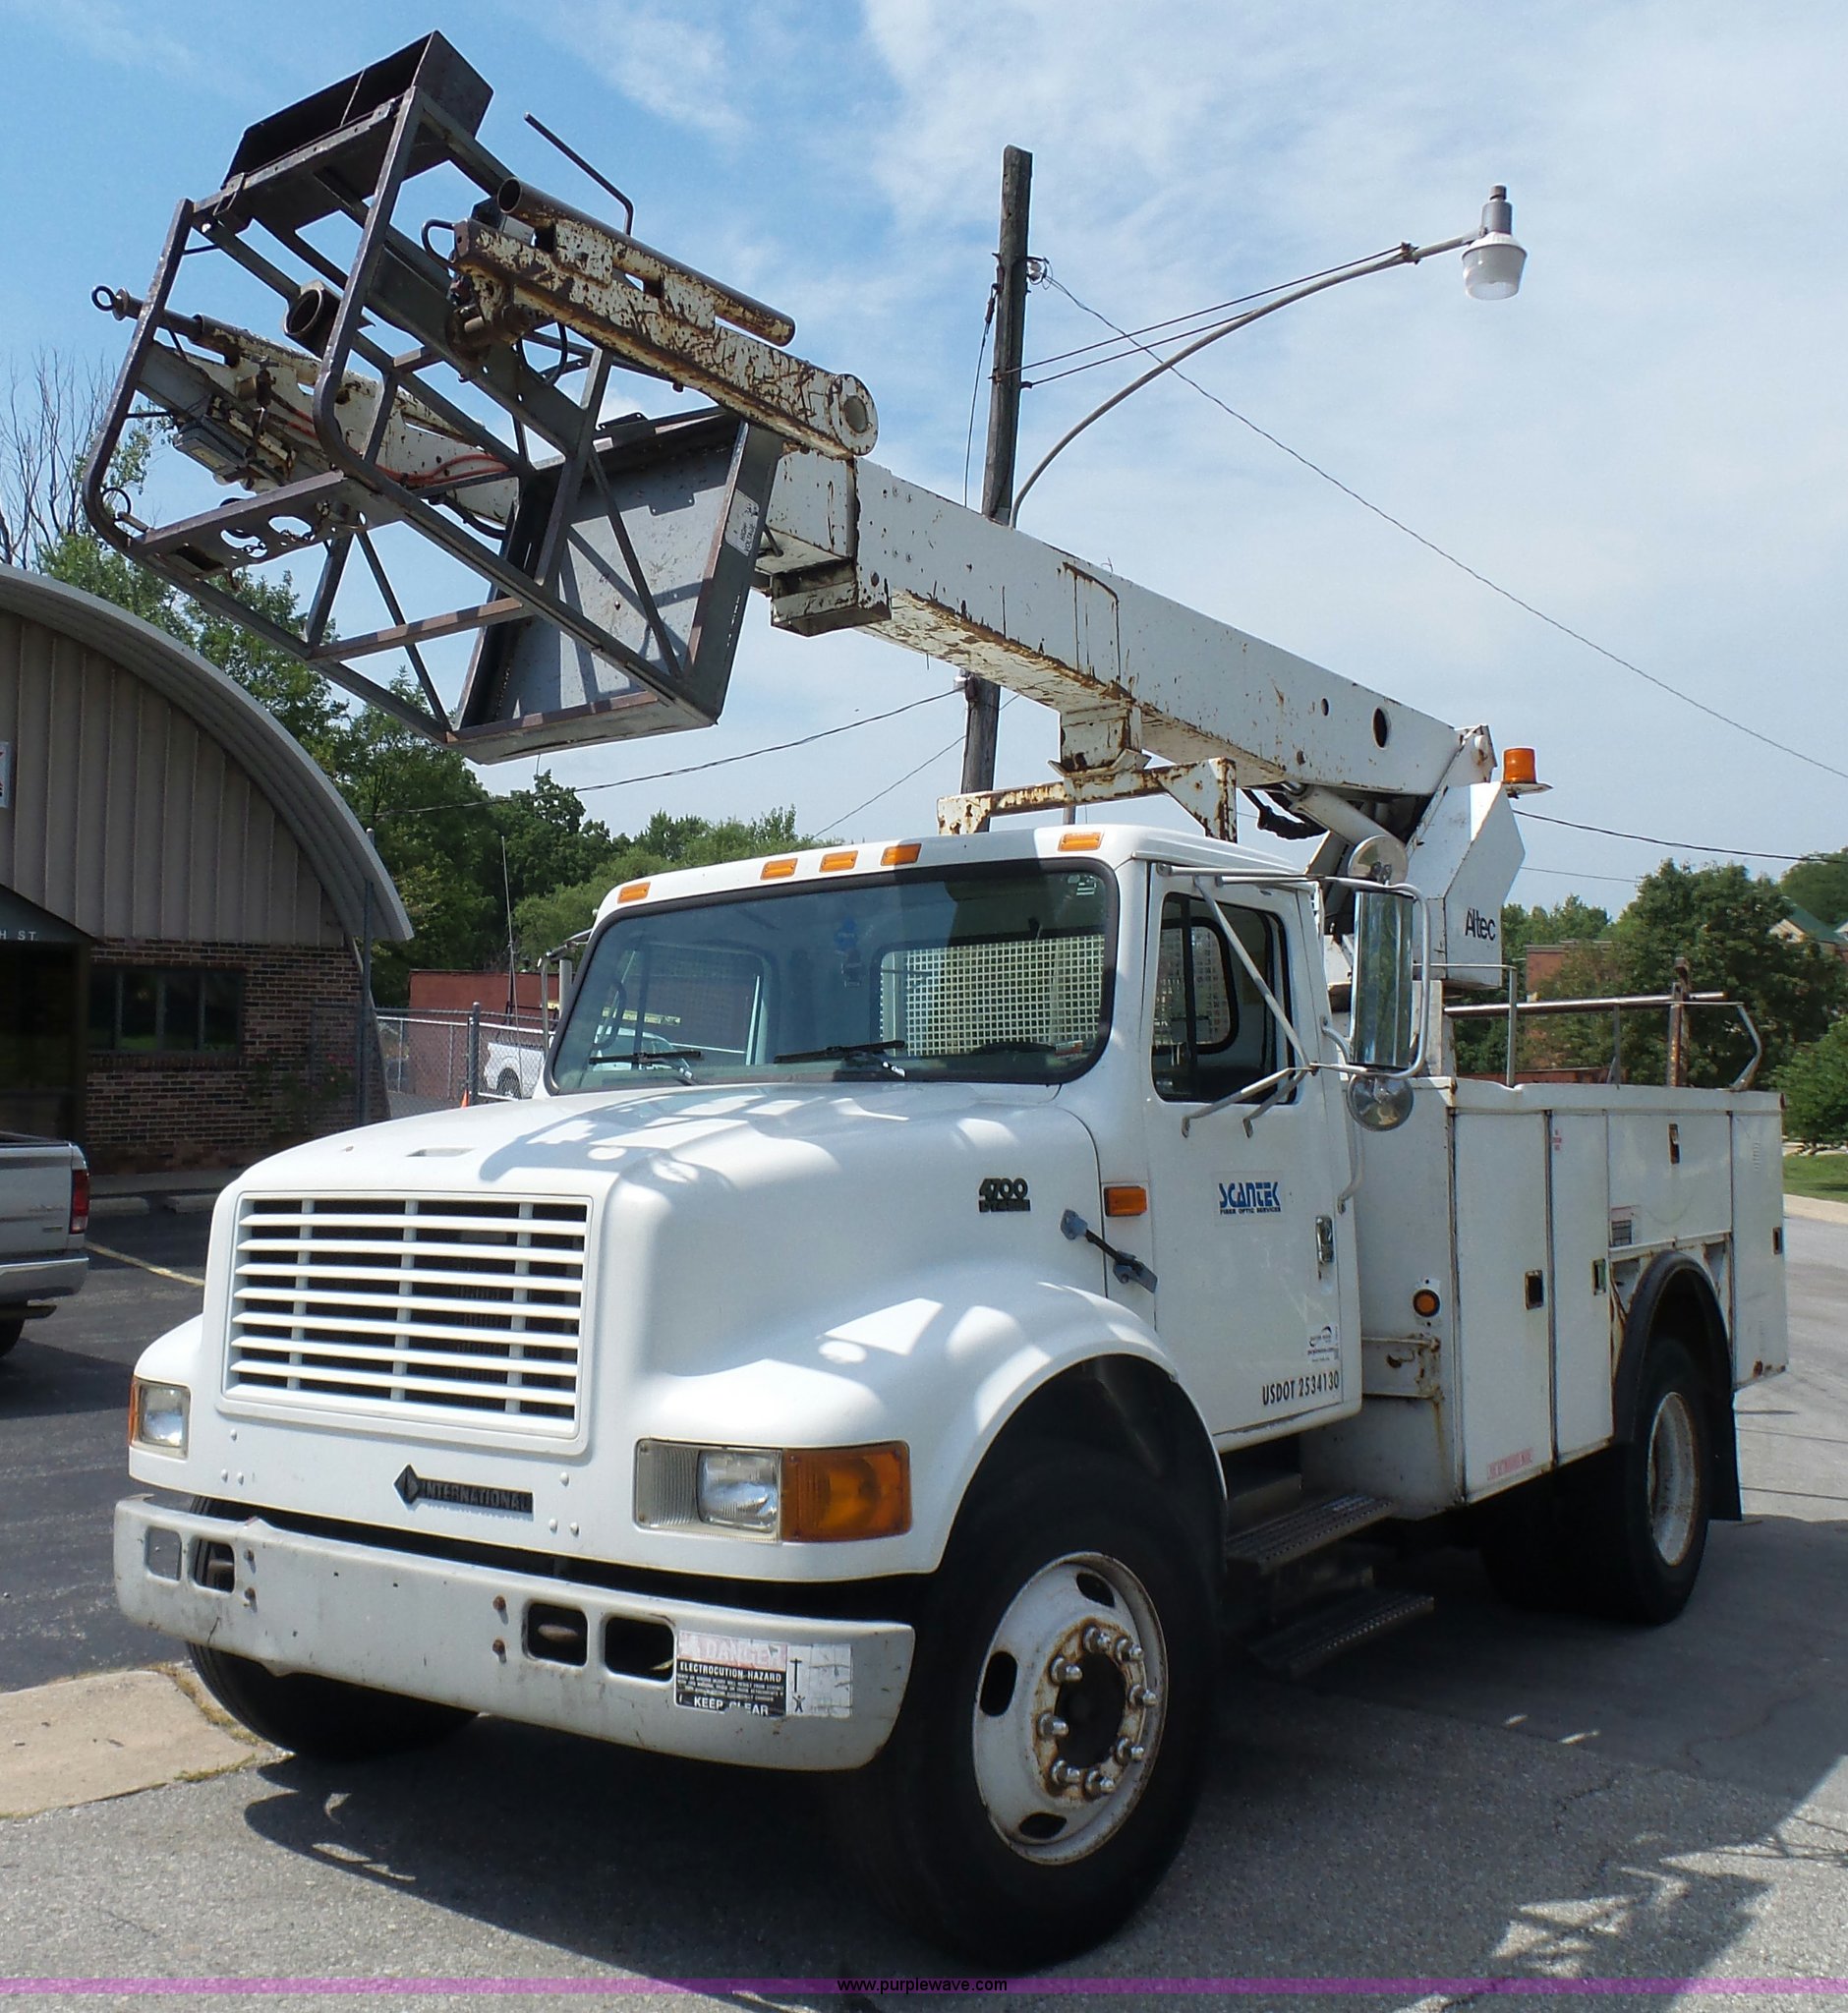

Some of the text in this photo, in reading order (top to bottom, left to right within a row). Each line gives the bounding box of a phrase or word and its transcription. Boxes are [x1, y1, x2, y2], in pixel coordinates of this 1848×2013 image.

[1465, 908, 1496, 941] Altec
[979, 1178, 1028, 1200] 4700
[1218, 1181, 1281, 1208] SCANTEK
[1262, 1370, 1339, 1406] USDOT 2534130
[423, 1480, 529, 1512] INTERNATIONAL
[680, 1661, 743, 1679] ELECTROCUTION
[747, 1671, 782, 1683] HAZARD
[694, 1696, 724, 1710] KEEP
